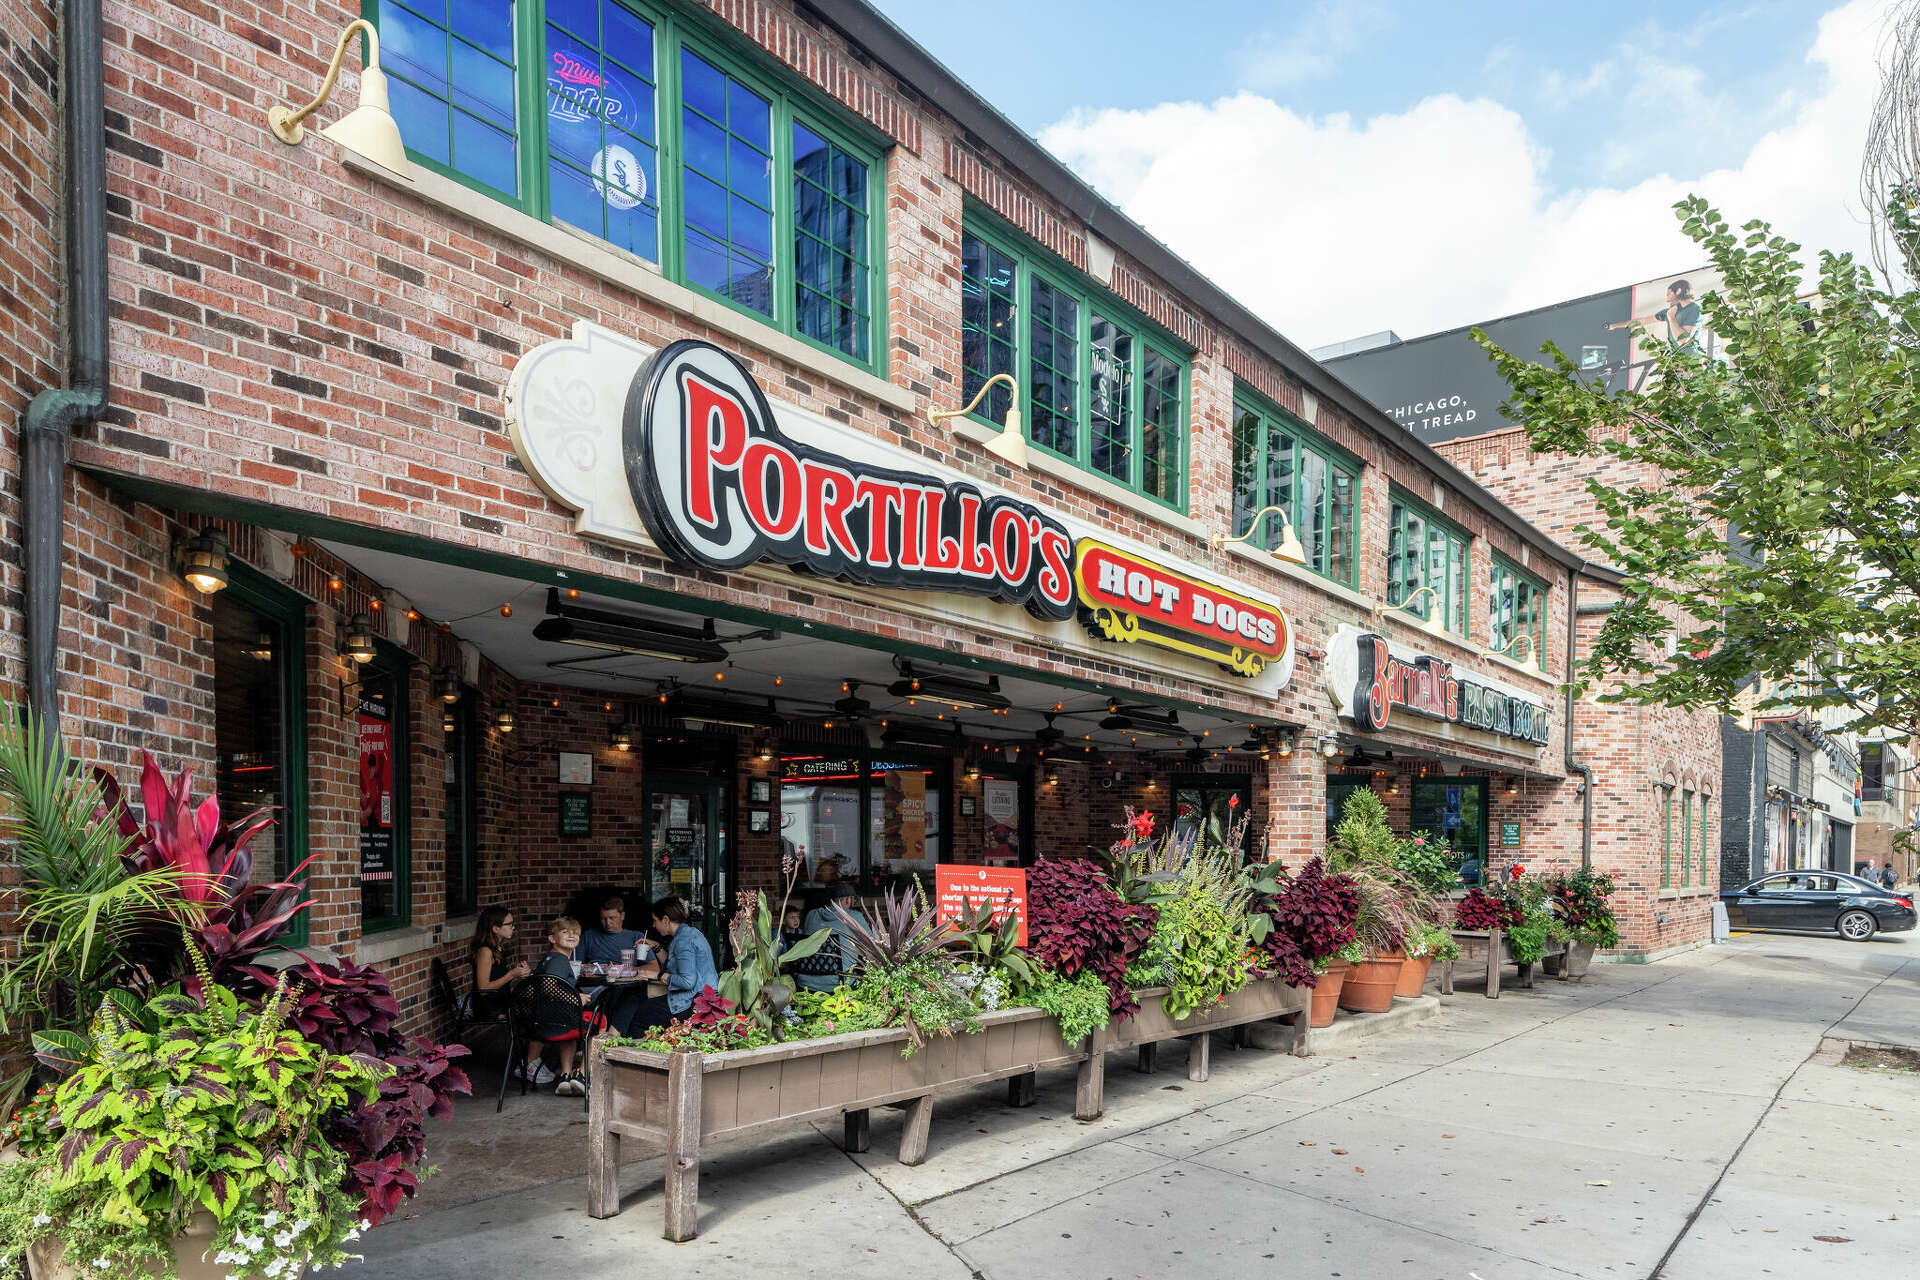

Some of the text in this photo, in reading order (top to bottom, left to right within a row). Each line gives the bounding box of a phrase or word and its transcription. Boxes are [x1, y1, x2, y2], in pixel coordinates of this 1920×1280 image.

[1422, 409, 1477, 430] TREAD
[1098, 558, 1277, 646] HOT DOGS
[1369, 638, 1459, 730] Barnelli's
[1463, 681, 1511, 735] PASTA
[803, 760, 848, 773] CATERING
[902, 798, 925, 808] SPICY
[950, 883, 962, 892] Due
[963, 884, 969, 892] to
[970, 884, 980, 892] the
[980, 884, 1002, 893] national
